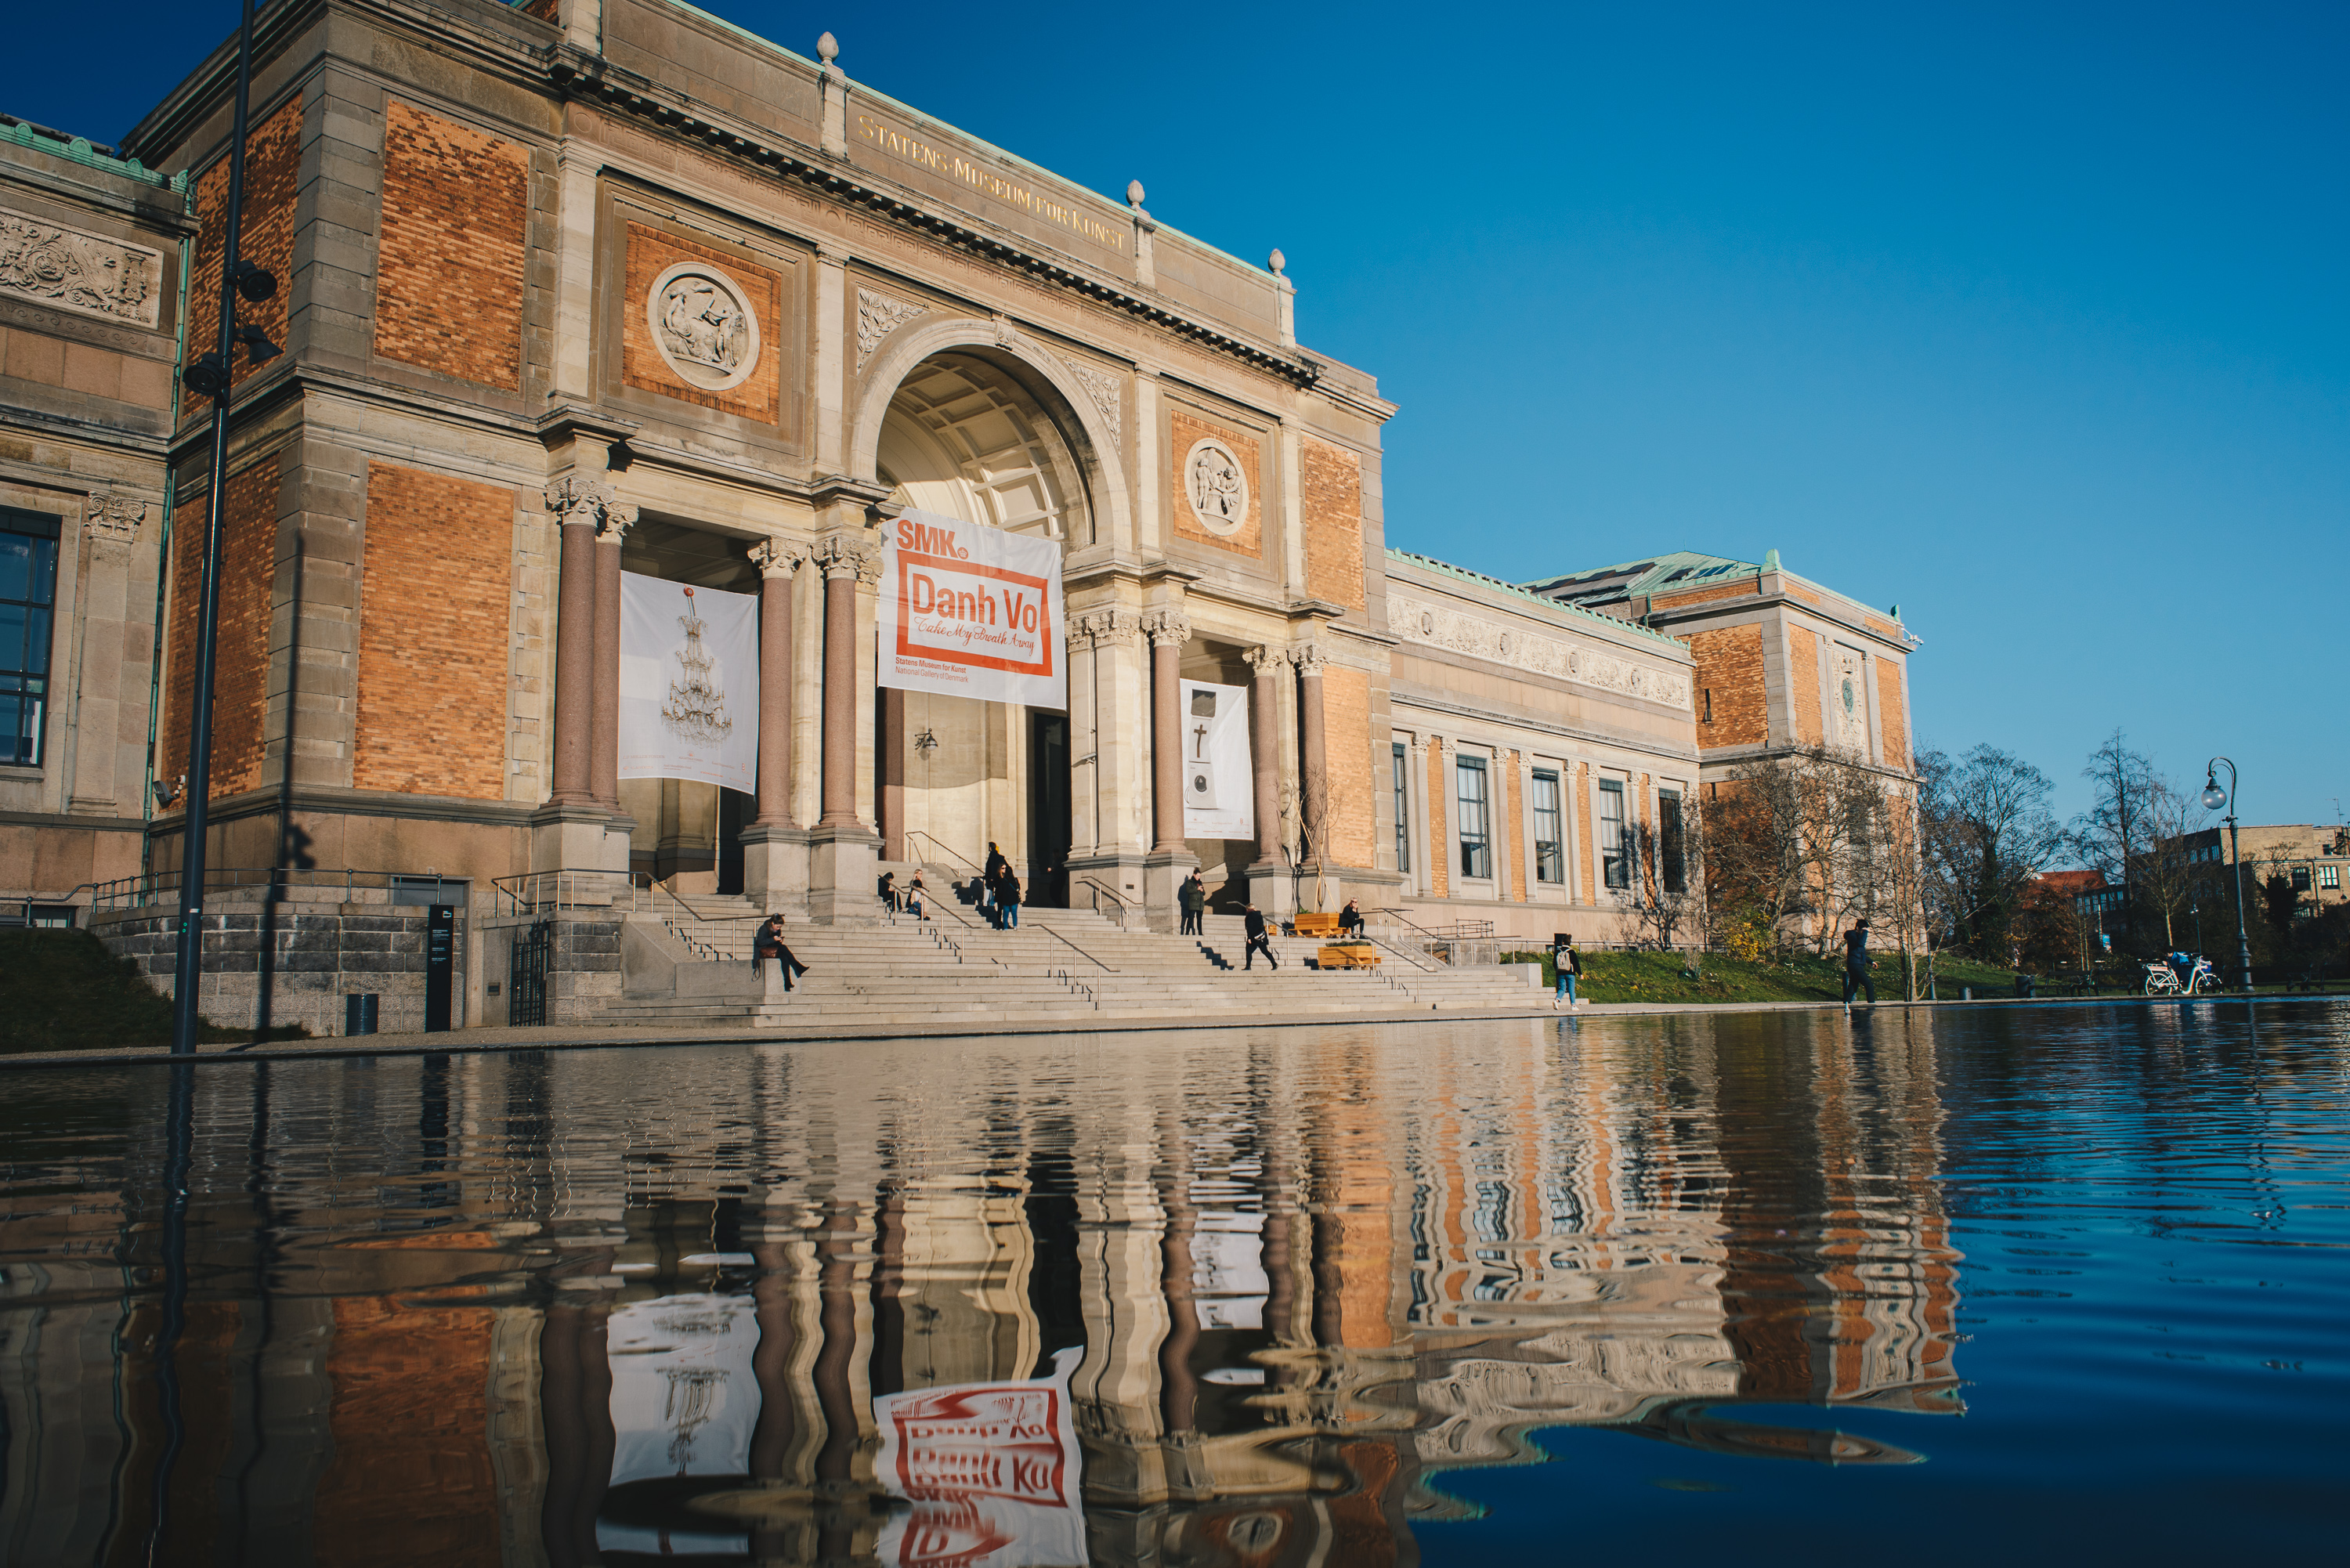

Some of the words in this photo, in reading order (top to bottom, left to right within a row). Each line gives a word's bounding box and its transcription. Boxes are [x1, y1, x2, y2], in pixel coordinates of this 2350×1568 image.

[913, 573, 996, 625] Danh
[1003, 588, 1037, 634] Vo
[914, 616, 947, 635] Take
[946, 623, 974, 646] My
[973, 626, 1007, 645] Breath
[1009, 632, 1035, 656] Away
[895, 656, 918, 667] Statens
[919, 659, 942, 670] Museum
[951, 665, 967, 674] Kunst
[895, 666, 920, 676] National
[920, 669, 939, 680] Gallery
[945, 673, 969, 683] Denmark
